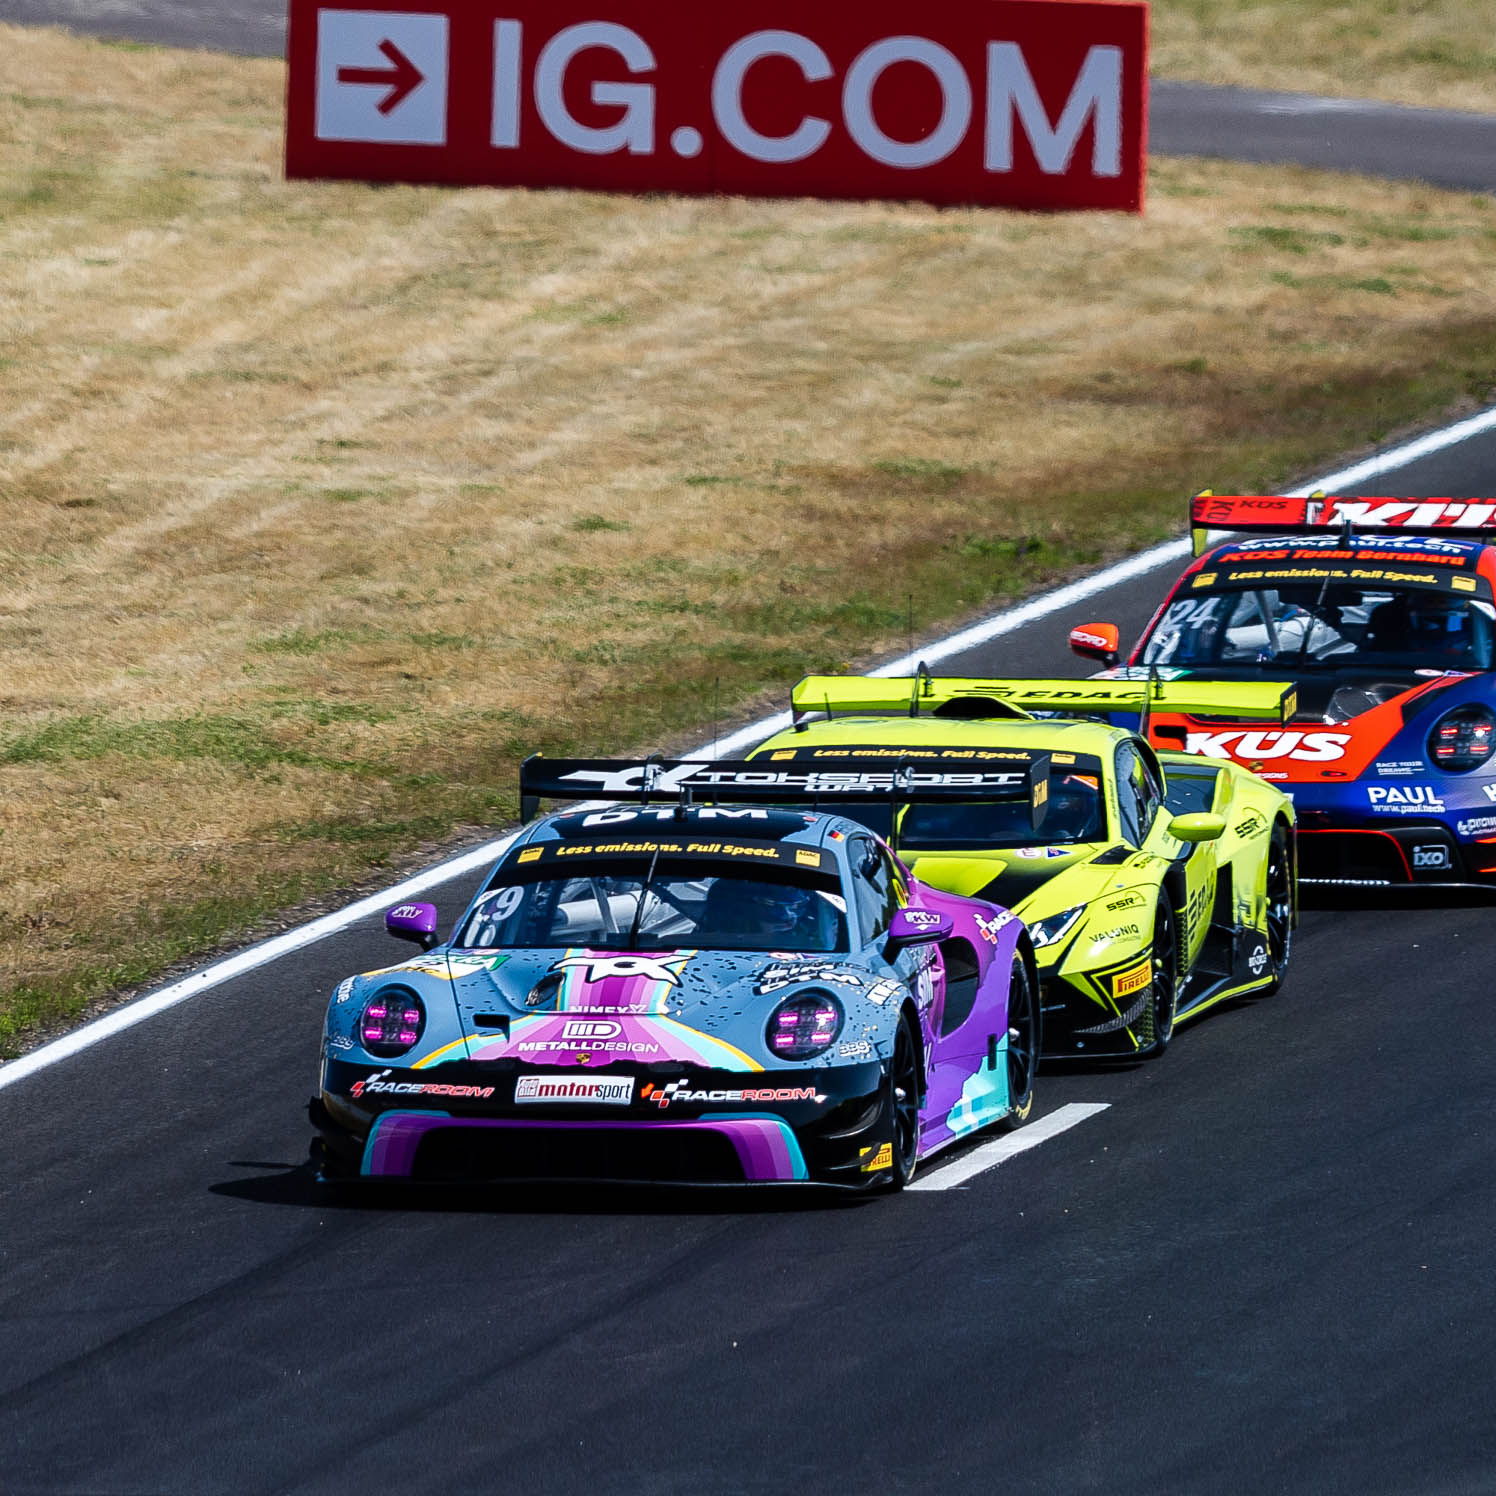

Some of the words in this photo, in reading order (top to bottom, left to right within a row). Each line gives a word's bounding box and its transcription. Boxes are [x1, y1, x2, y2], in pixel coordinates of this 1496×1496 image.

[492, 20, 1122, 176] IG.COM
[1238, 538, 1462, 554] www.pul.tech
[1292, 549, 1354, 561] Team
[1356, 550, 1467, 566] Bernhard
[1228, 571, 1264, 581] Less
[1350, 569, 1382, 579] Full
[1384, 570, 1438, 584] Speed.
[1165, 597, 1221, 631] 24
[813, 749, 848, 758] Less
[852, 749, 938, 758] emissions.
[941, 750, 975, 759] Full
[976, 751, 1032, 761] Speed.
[1184, 730, 1352, 762] KÜS
[1366, 786, 1445, 805] PAUL
[582, 806, 770, 828] DTM
[556, 844, 593, 857] Less
[594, 841, 683, 854] emissions.
[686, 843, 720, 854] Full
[720, 845, 781, 859] Speed.
[1106, 897, 1136, 912] SSR
[1117, 966, 1151, 994] PIRELLI
[517, 1040, 660, 1054] METALLDESIGN
[367, 1080, 495, 1099] RACEROOM
[538, 1081, 632, 1103] motorsport
[672, 1087, 817, 1103] RACEROOM
